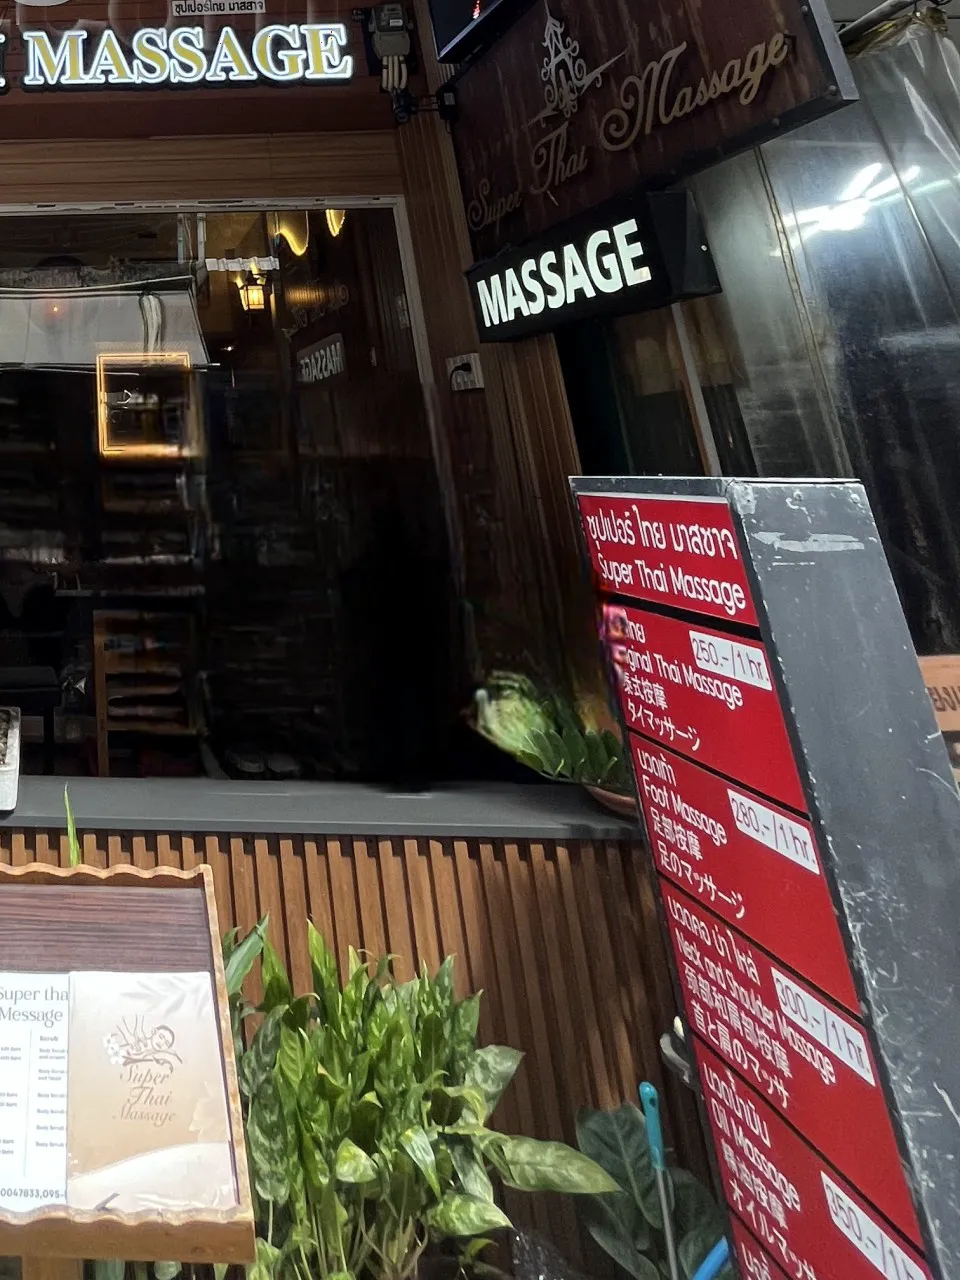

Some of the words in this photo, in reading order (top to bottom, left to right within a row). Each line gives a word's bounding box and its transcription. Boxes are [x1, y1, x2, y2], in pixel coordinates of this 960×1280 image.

[23, 23, 356, 88] MASSAGE
[468, 178, 522, 235] Super
[529, 121, 588, 194] Thai
[600, 33, 788, 151] Massage
[476, 218, 652, 328] MASSAGE
[587, 508, 635, 550] ซุปเปอร์
[632, 504, 667, 550] ไทย
[670, 523, 739, 560] มาสซาจ
[597, 552, 634, 588] Super
[635, 559, 670, 594] Thai
[669, 565, 746, 616] Massage
[653, 653, 683, 685] Thai
[682, 663, 744, 711] Massage
[628, 698, 701, 752] タイマッサージ
[642, 775, 670, 810] Foot
[671, 790, 728, 847] Massage
[651, 806, 703, 861] 足部按摩
[657, 839, 746, 919] 足のマッサージ
[674, 927, 705, 971] Neck
[704, 956, 727, 990] and
[725, 968, 777, 1034] Shoulder
[776, 1010, 836, 1086] Massage
[119, 1062, 170, 1087] Super
[126, 1086, 173, 1107] Thai
[710, 1097, 731, 1137] Oil
[730, 1116, 801, 1212] Massage
